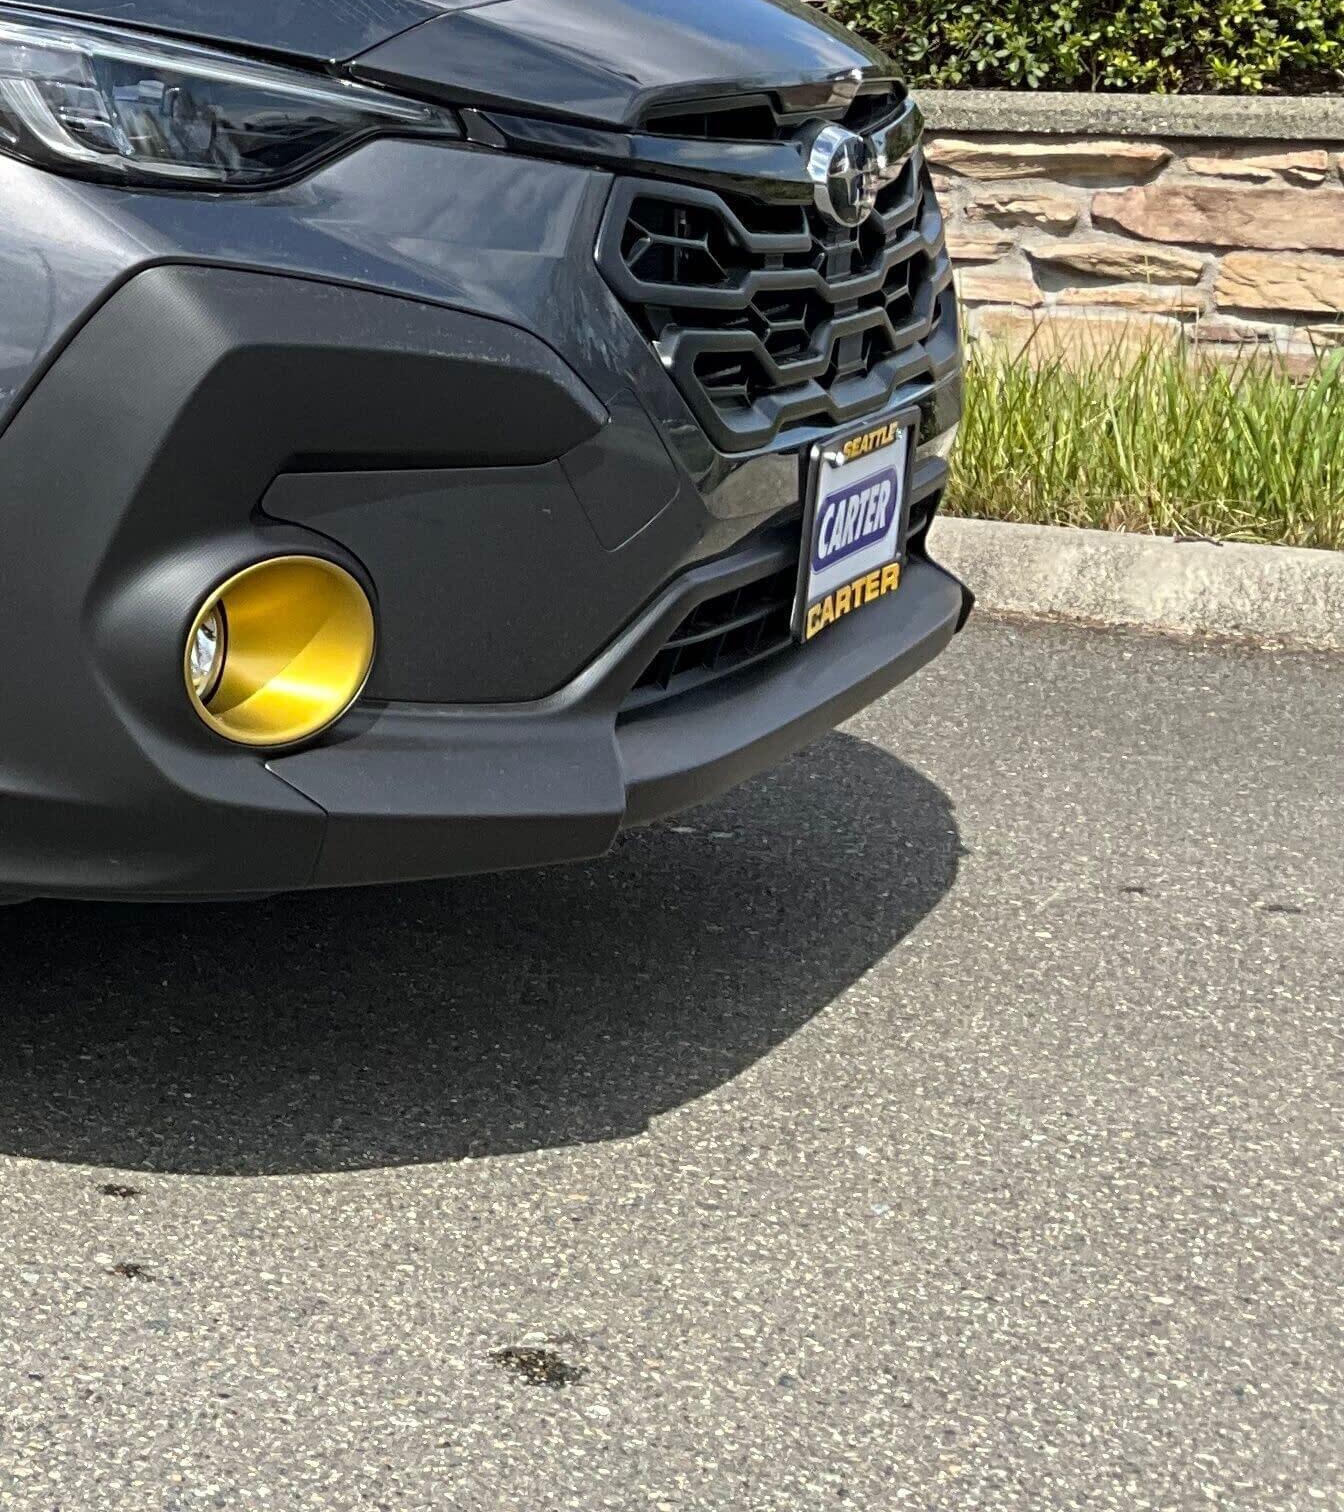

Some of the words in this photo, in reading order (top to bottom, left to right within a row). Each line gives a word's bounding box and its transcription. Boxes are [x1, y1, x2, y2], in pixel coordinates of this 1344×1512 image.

[842, 421, 899, 460] SEATTLE
[817, 479, 892, 560] CARTER
[806, 562, 901, 640] CARTER
